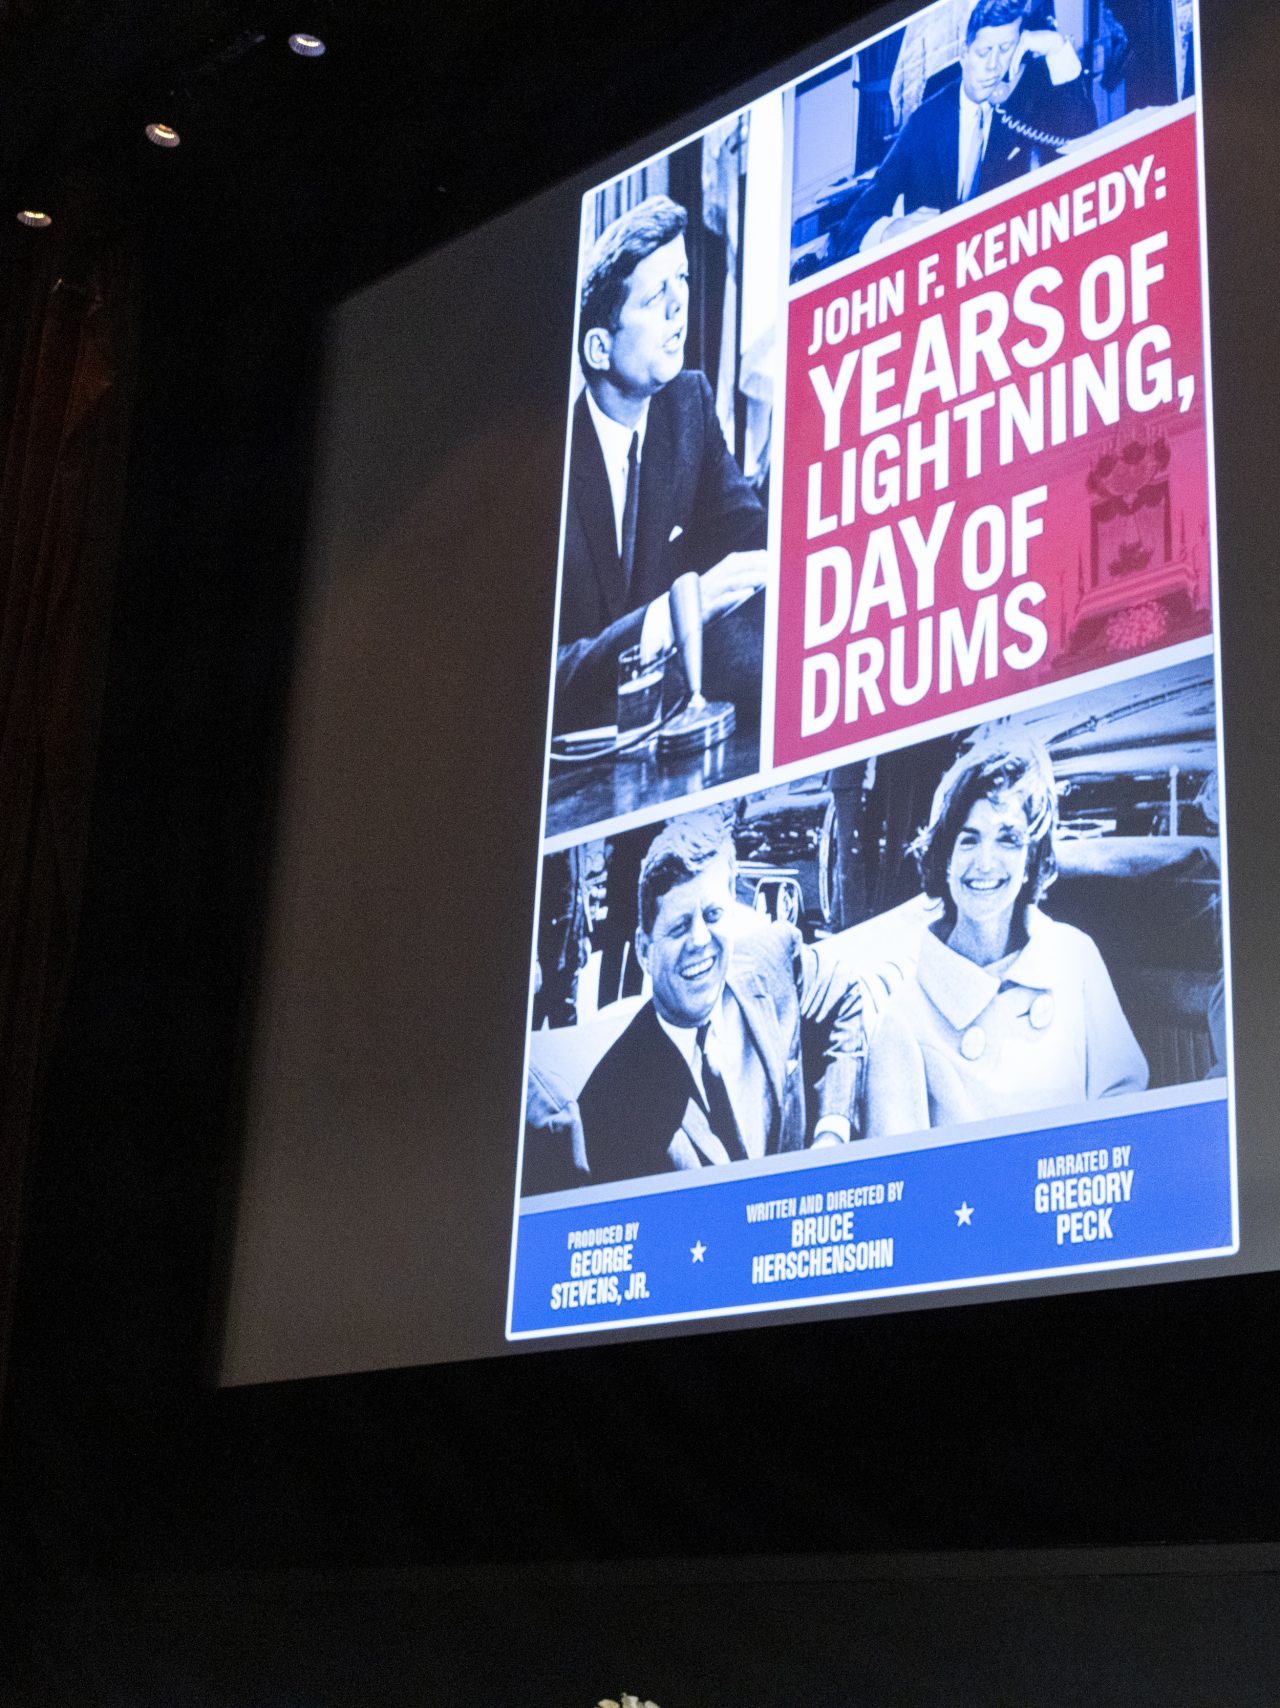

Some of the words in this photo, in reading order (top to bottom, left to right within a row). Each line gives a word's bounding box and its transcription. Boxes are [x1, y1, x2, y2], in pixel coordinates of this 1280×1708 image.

[808, 269, 904, 355] JOHN
[918, 253, 945, 306] F.
[957, 154, 1167, 288] KENNEDY:
[808, 265, 1065, 451] YEARS
[1079, 230, 1168, 341] OF
[807, 324, 1195, 540] LIGHTNING,
[804, 500, 956, 650] DAY
[962, 485, 1048, 591] OF
[800, 581, 1048, 738] DRUMS
[1037, 1149, 1109, 1179] NARRATED
[1111, 1145, 1131, 1167] BY
[746, 1198, 797, 1223] WRITTEN
[799, 1194, 823, 1217] AND
[825, 1186, 884, 1213] DIRECTED
[887, 1180, 904, 1202] BY
[1034, 1170, 1134, 1214] GREGORY
[567, 1227, 622, 1250] PRODUCED
[624, 1222, 640, 1242] BY
[791, 1212, 854, 1248] BRUCE
[1056, 1207, 1113, 1245] PECK
[570, 1244, 633, 1279] GEORGE
[751, 1238, 893, 1284] HERSCHENSOHN
[550, 1276, 622, 1311] STEVENS,
[624, 1271, 650, 1300] JR.
